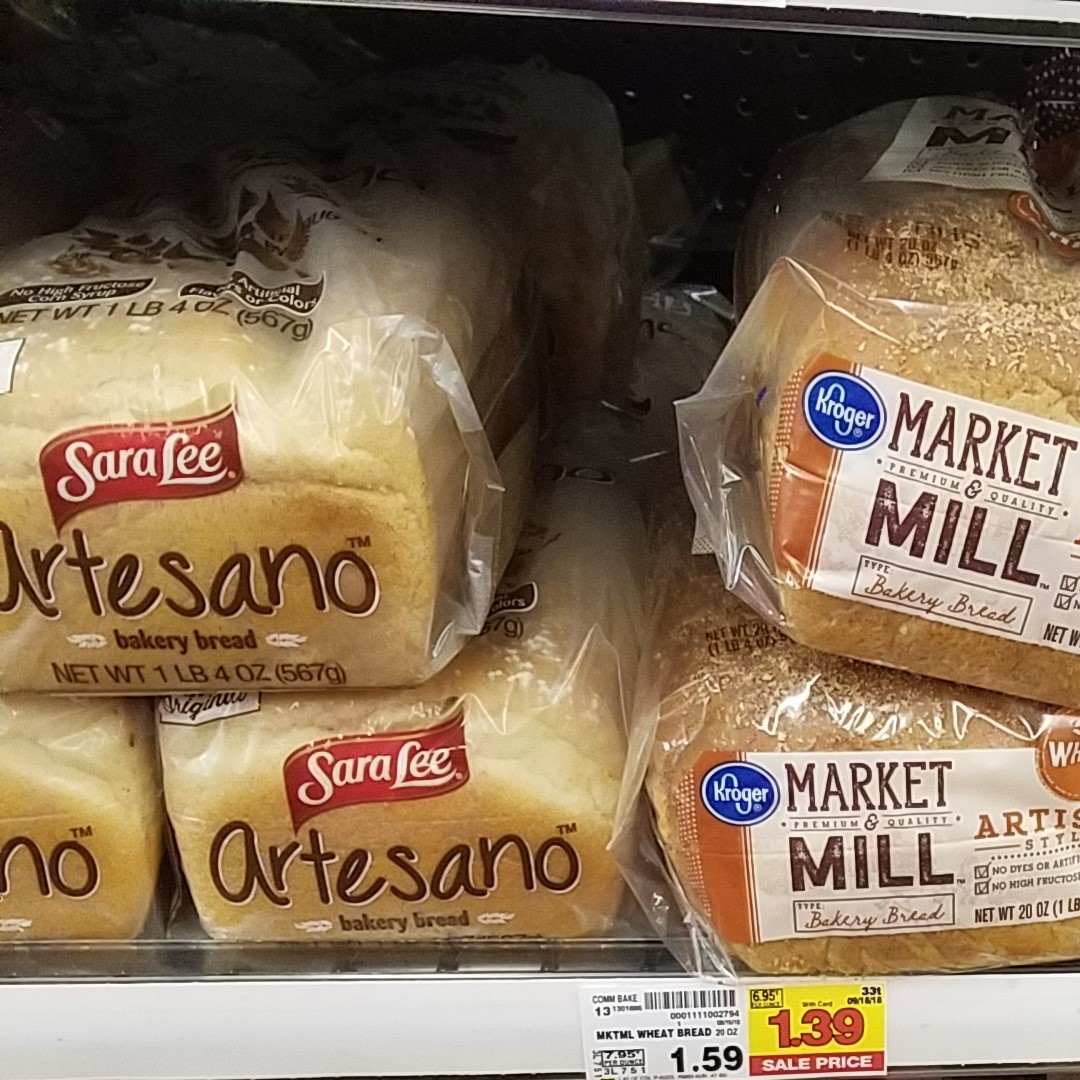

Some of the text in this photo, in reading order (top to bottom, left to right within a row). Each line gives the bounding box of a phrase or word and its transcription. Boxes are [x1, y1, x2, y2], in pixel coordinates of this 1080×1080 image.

[815, 383, 875, 431] Kroger
[888, 392, 1078, 496] MARKET
[864, 478, 1040, 587] MILL
[114, 629, 258, 653] bakery bread
[1043, 623, 1068, 643] NET
[53, 663, 347, 686] NET WT LB OZ (567g)
[713, 775, 768, 815] Kroger
[785, 760, 952, 811] MARKET
[790, 832, 954, 892] MILL
[883, 907, 945, 925] Bread
[1019, 901, 1049, 920] 20 OZ
[338, 911, 470, 934] bakery bread
[618, 994, 638, 1002] BAKE
[595, 1007, 611, 1016] 13
[597, 1028, 711, 1039] MKTML WHEAT BREAD
[768, 1007, 865, 1048] 1.39
[671, 1046, 743, 1072] 1.59
[761, 1055, 873, 1071] SALE PRICE
